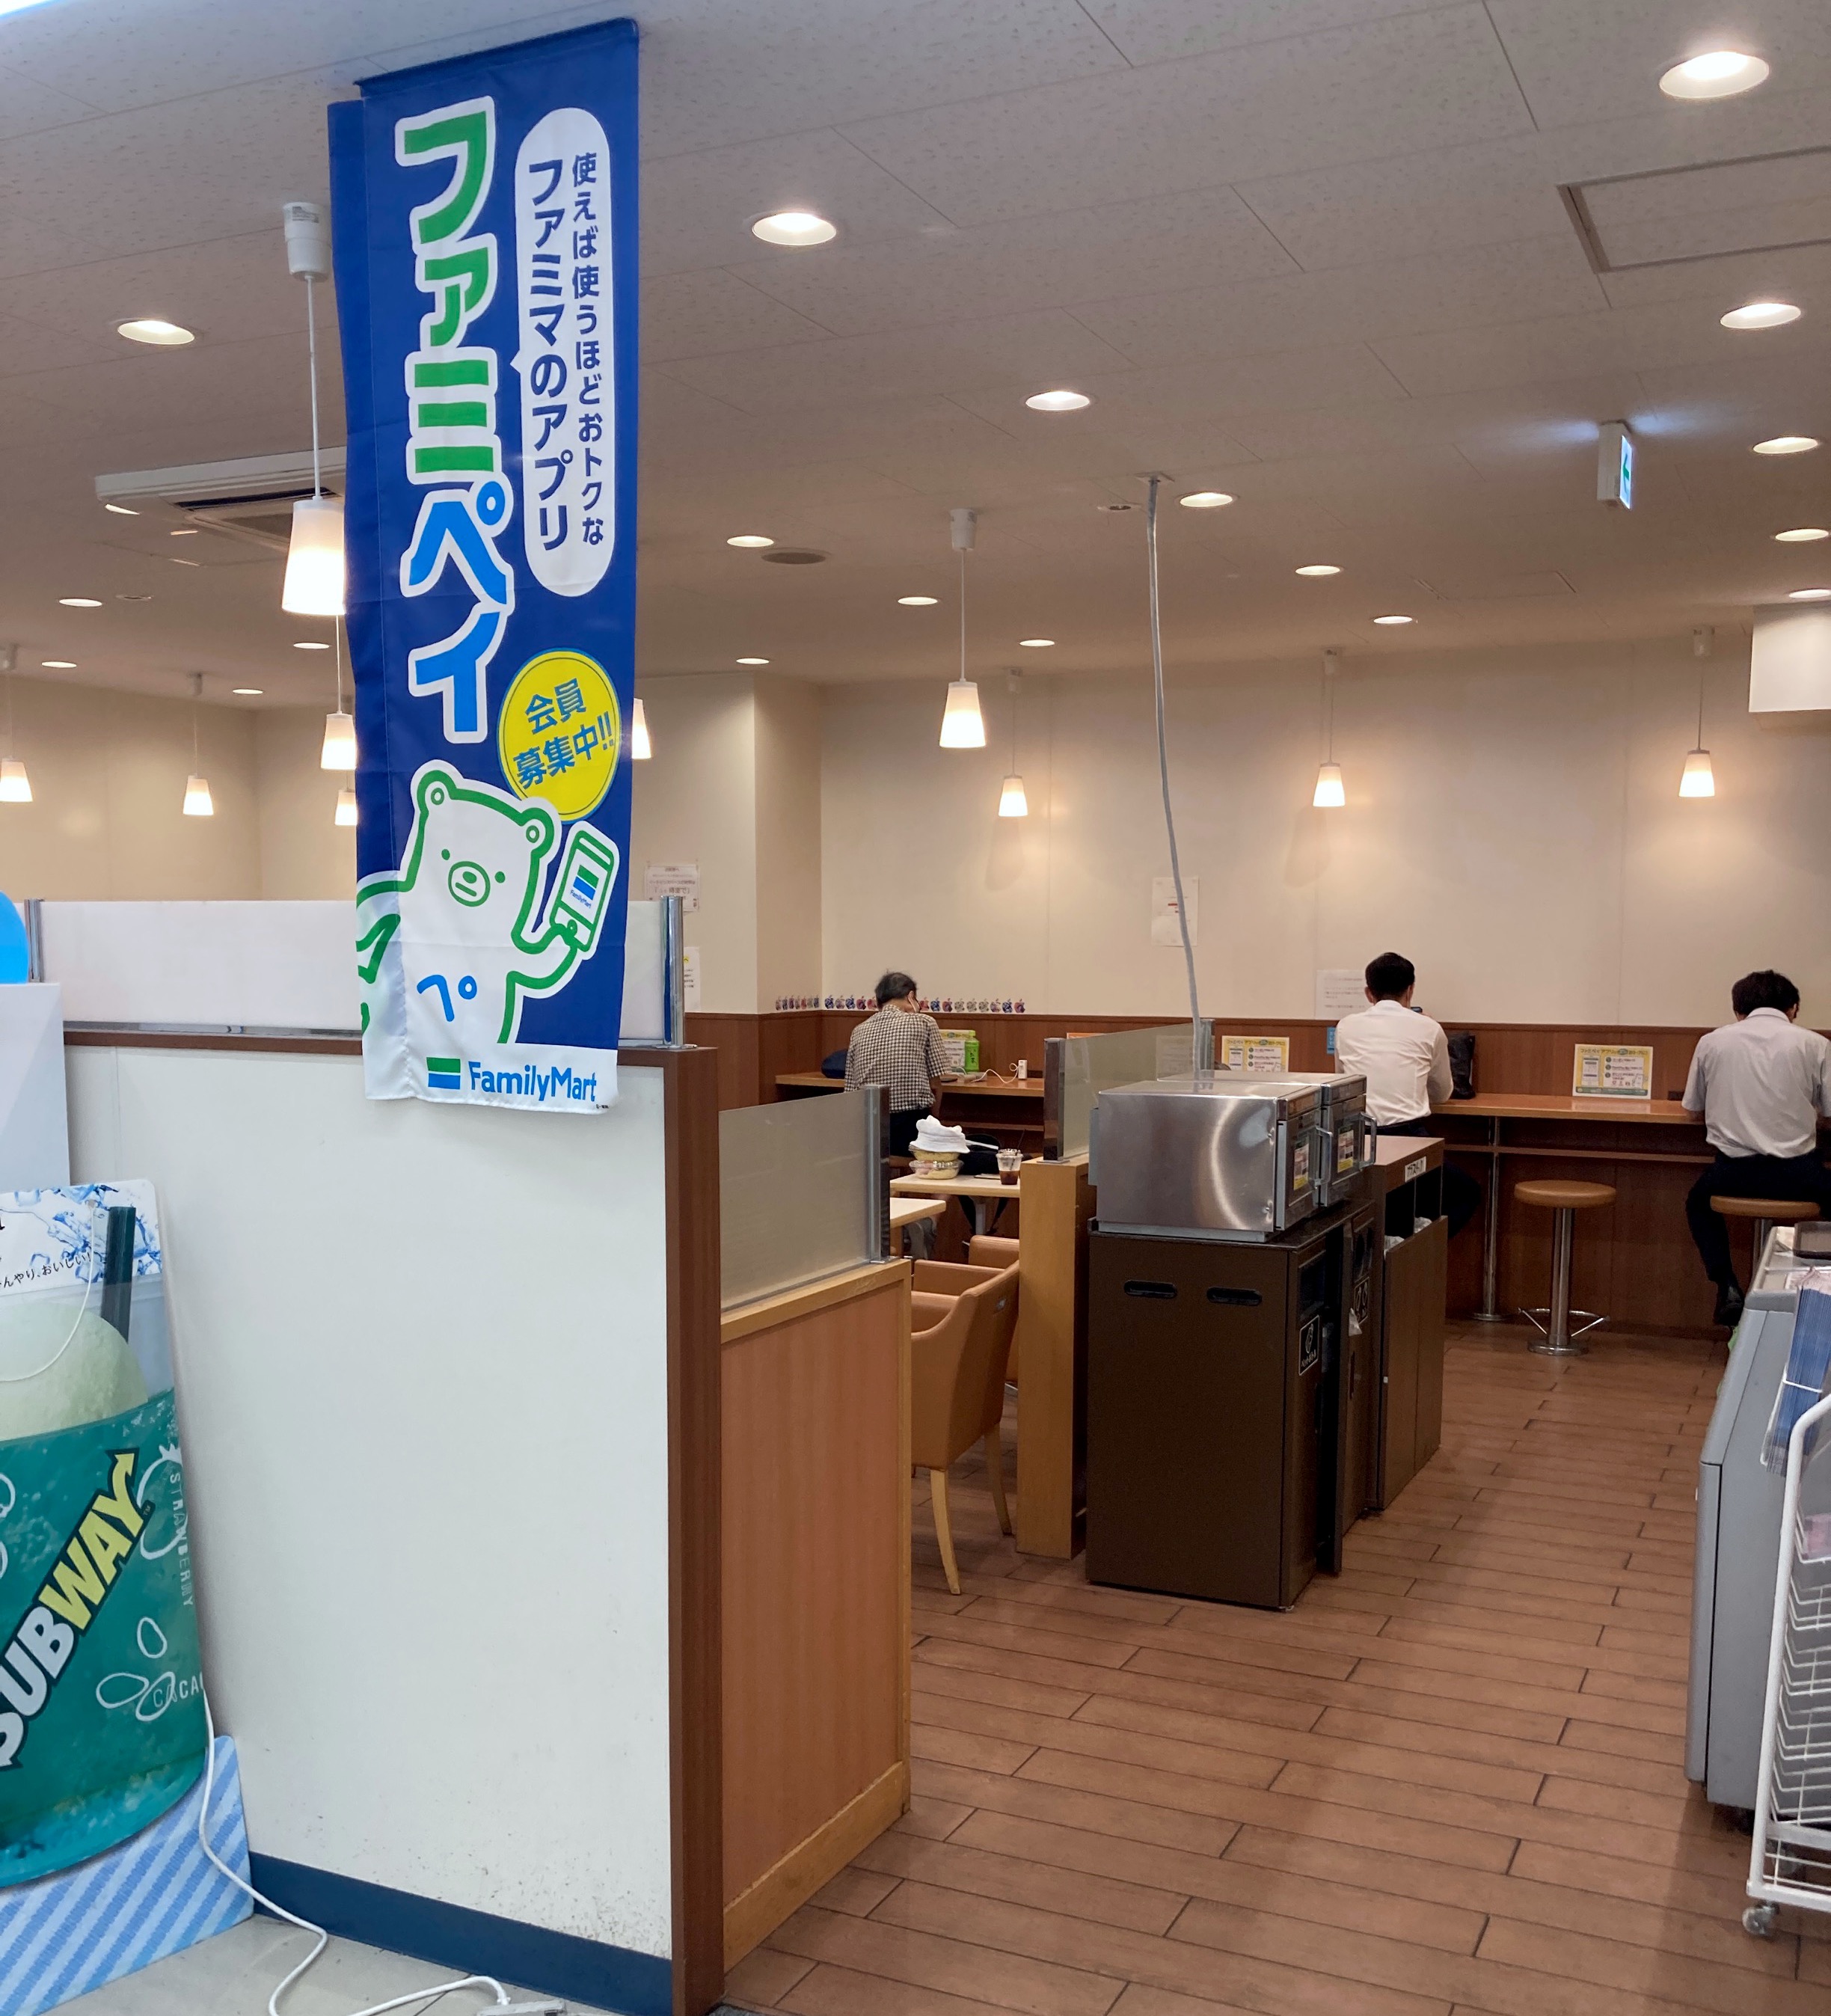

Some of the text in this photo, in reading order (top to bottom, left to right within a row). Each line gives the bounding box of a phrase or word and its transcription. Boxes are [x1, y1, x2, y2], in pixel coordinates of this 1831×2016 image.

[528, 158, 574, 552] ファミマのアプリ
[571, 151, 604, 547] 使えば使うほどおトクな
[396, 96, 515, 745] ファミペイ
[525, 678, 586, 735] 会員
[513, 711, 614, 789] 募集中!!
[416, 974, 477, 1022] ペ
[468, 1061, 598, 1103] FamilyMart
[0, 1251, 91, 1288] んやり、おいしい!
